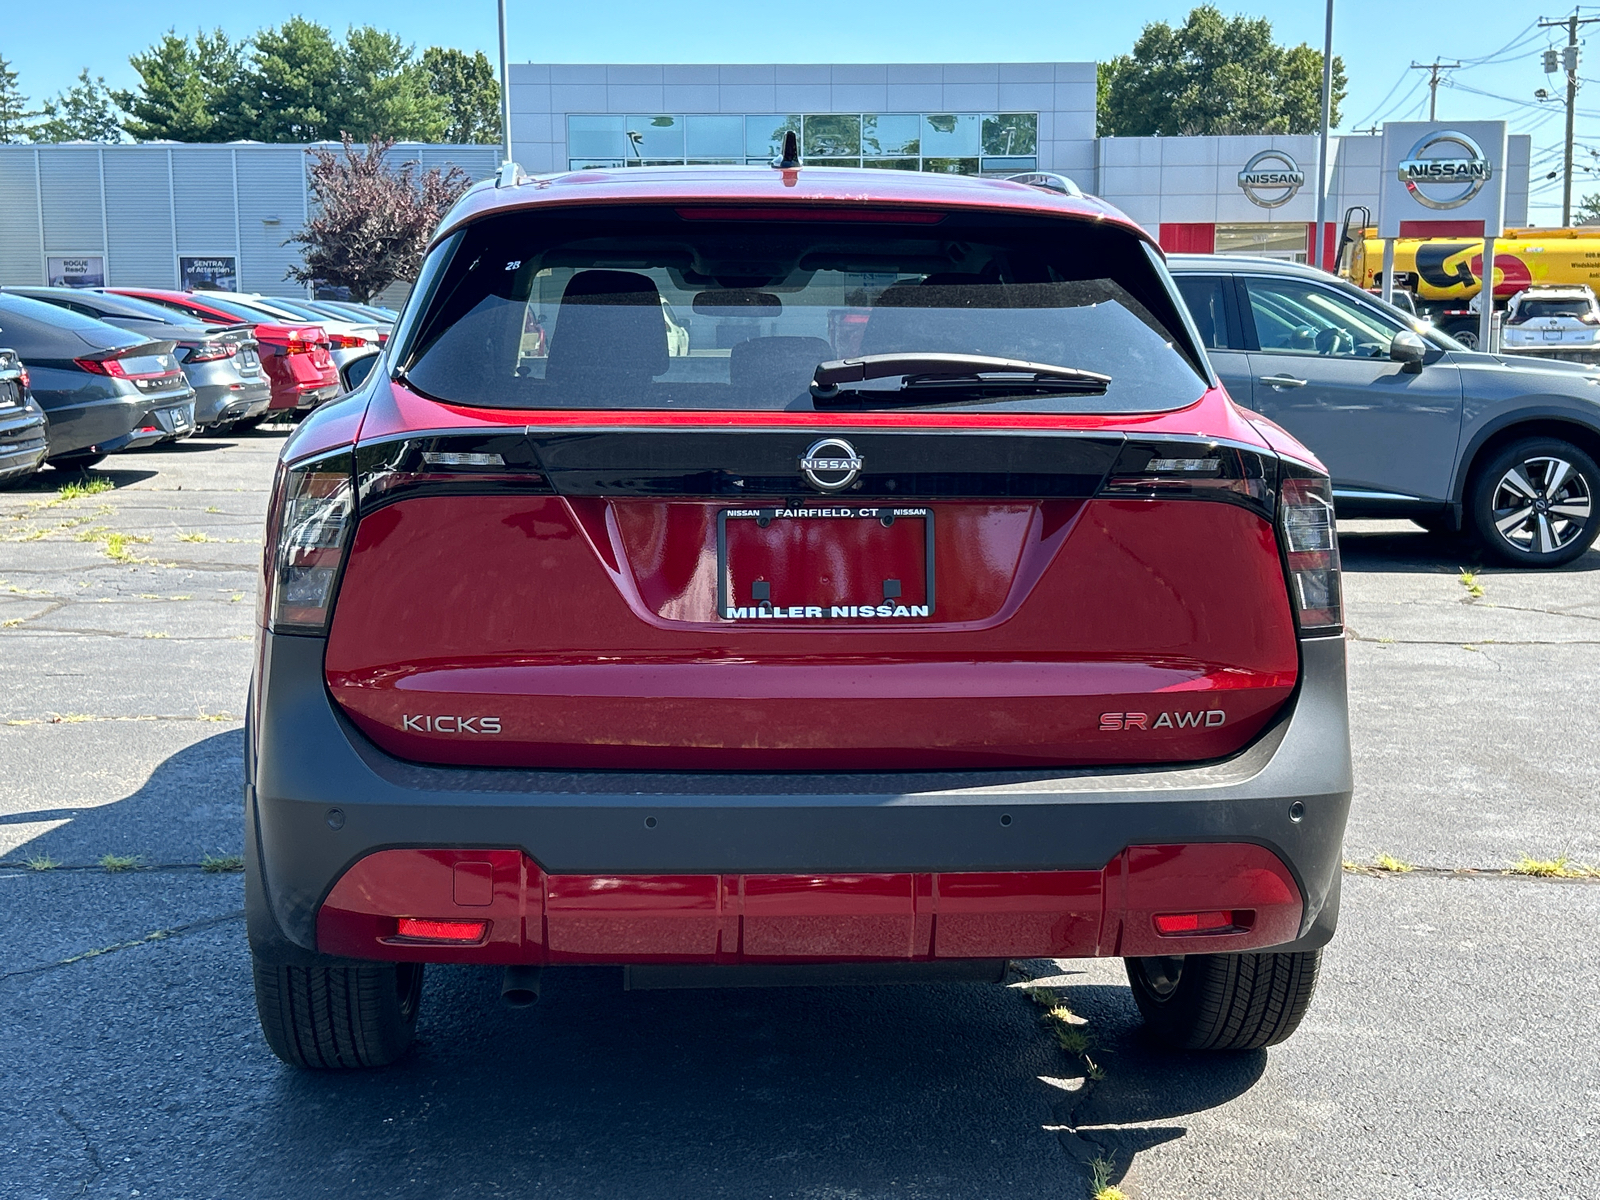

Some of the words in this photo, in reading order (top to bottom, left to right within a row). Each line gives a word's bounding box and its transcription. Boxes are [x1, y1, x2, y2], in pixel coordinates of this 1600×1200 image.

[1408, 163, 1484, 176] NISSAN
[1245, 174, 1299, 184] NISSAN
[64, 266, 88, 274] Ready
[801, 460, 861, 469] NISSAN
[775, 508, 855, 518] FAIRFIELD,
[858, 508, 879, 517] CT
[893, 508, 927, 516] NISSAN
[726, 606, 822, 618] MILLER
[831, 605, 929, 617] NISSAN
[402, 714, 502, 734] KICKS
[1099, 712, 1148, 731] SR
[1152, 709, 1226, 730] AWD
